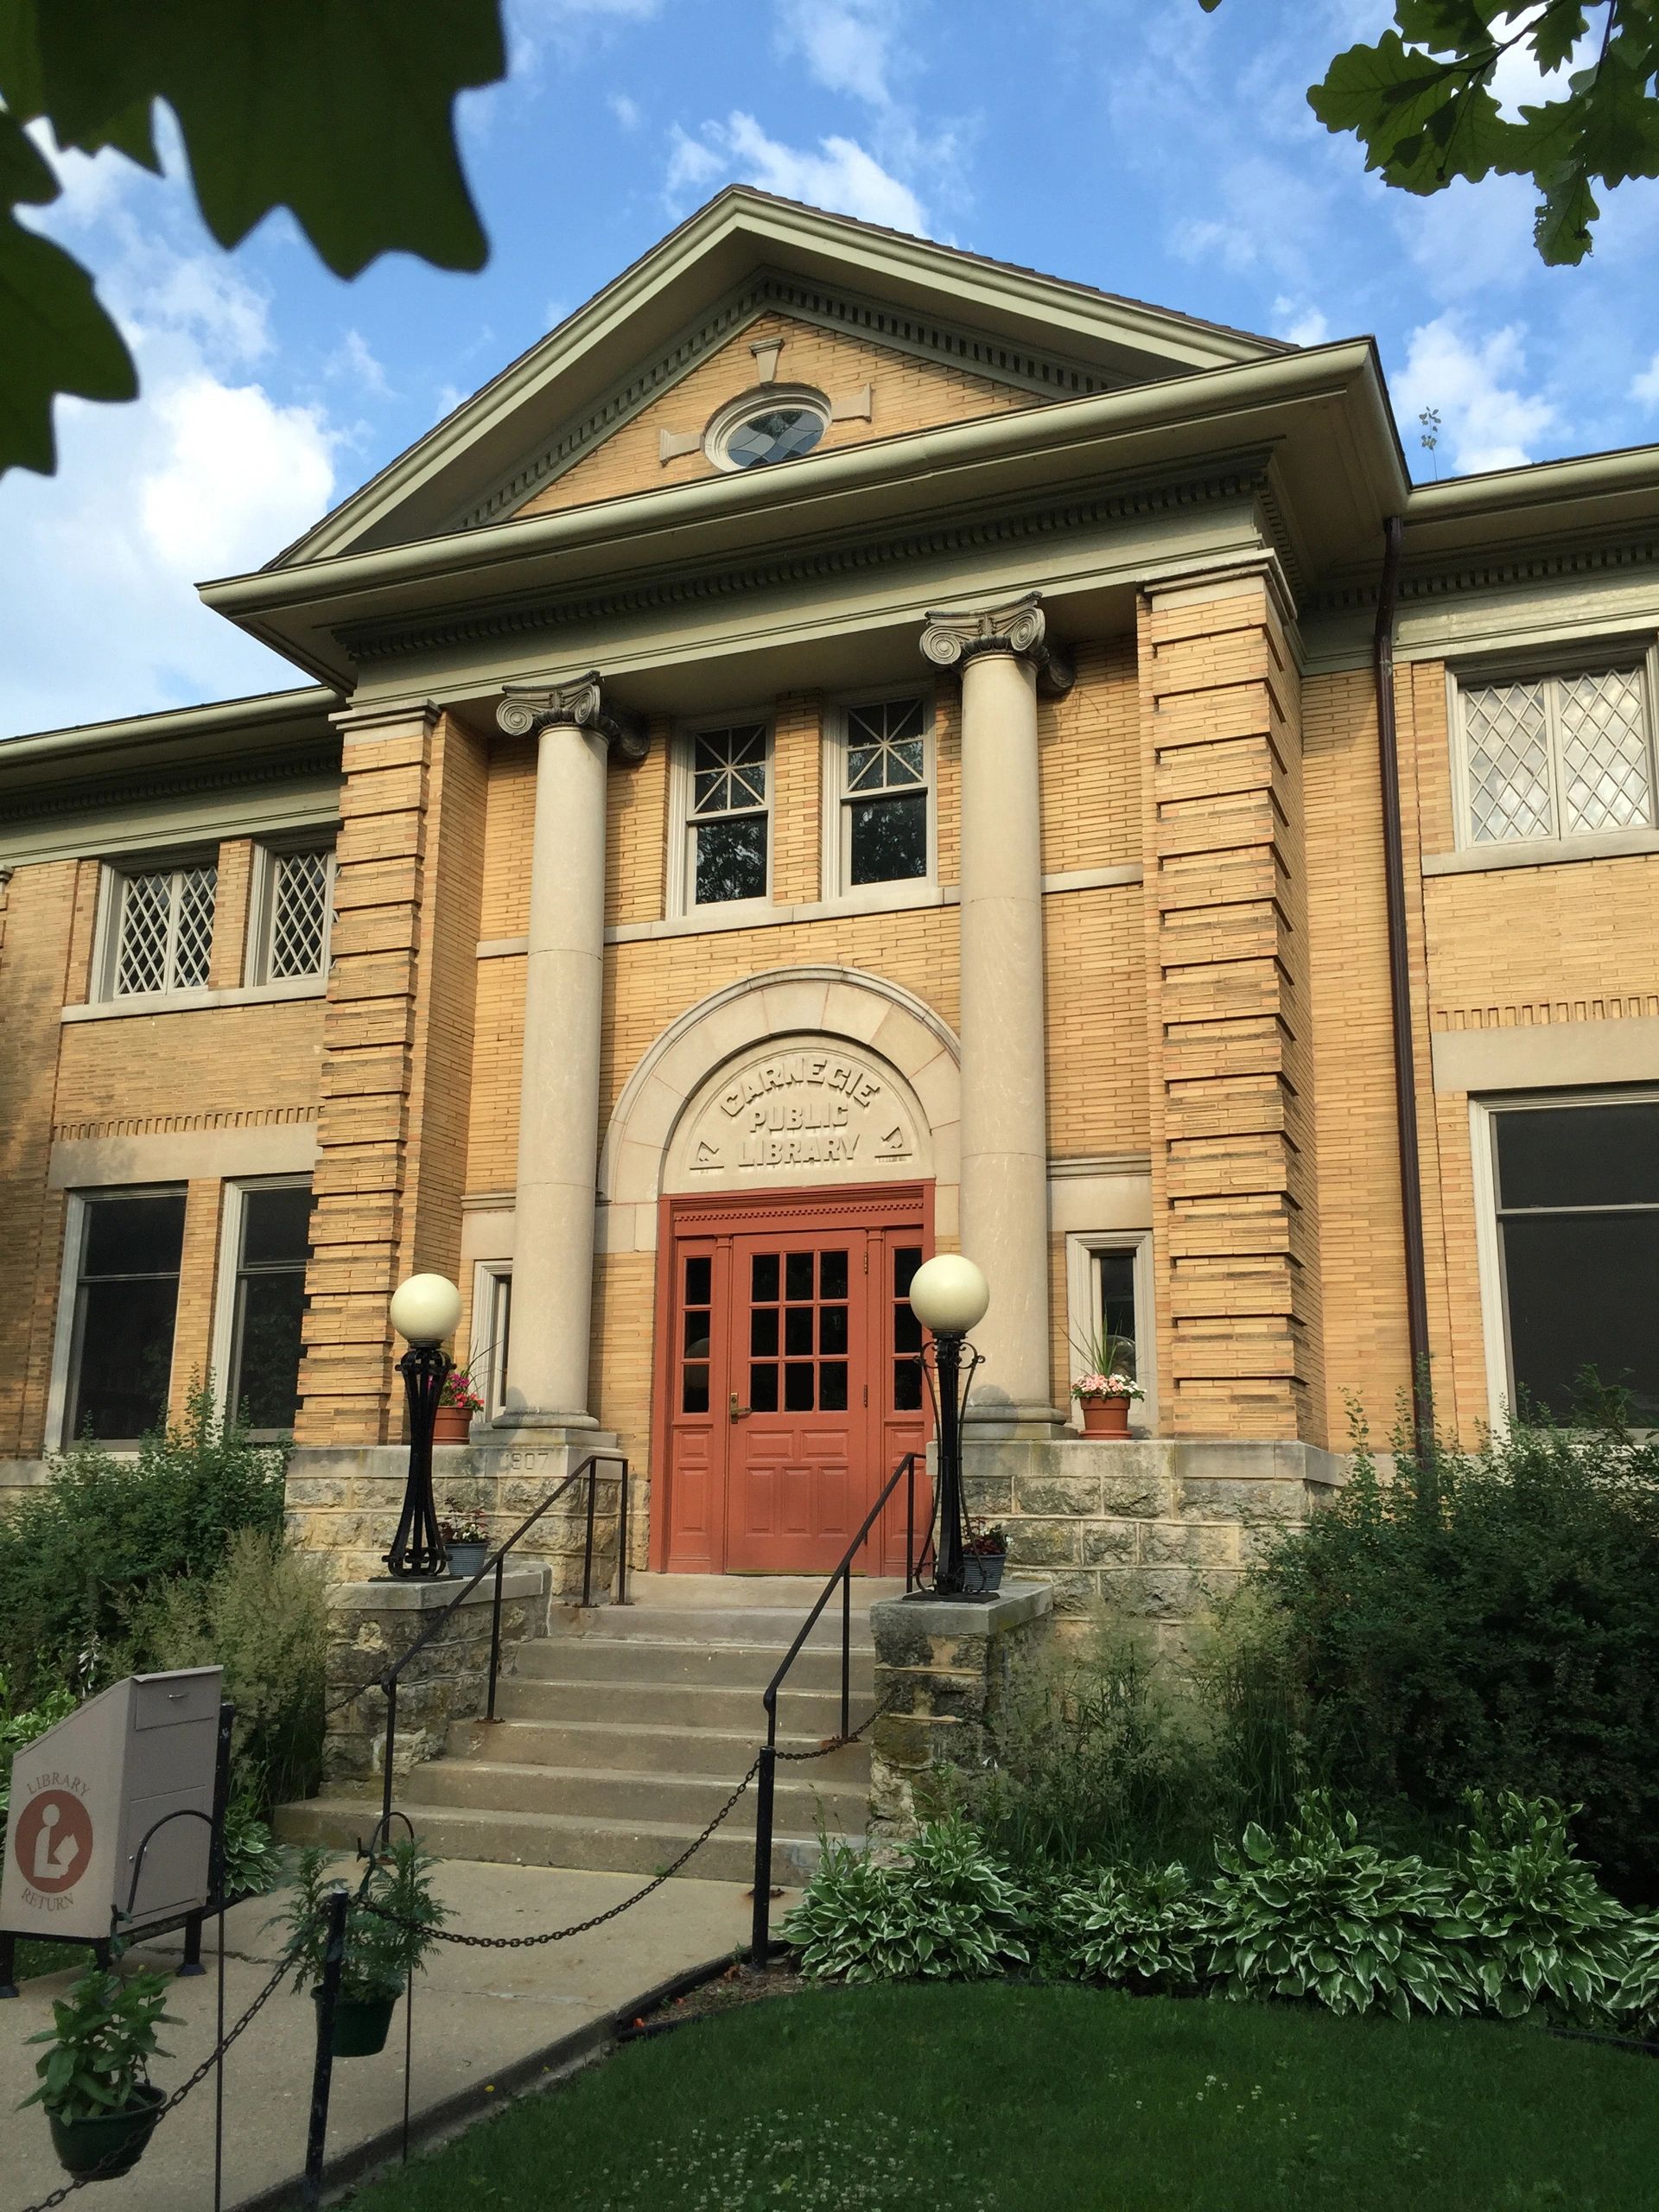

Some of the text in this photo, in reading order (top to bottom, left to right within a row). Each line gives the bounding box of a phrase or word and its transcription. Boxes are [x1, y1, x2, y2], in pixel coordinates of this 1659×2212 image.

[720, 1057, 880, 1116] CARNEGIE
[749, 1103, 849, 1133] PUBLIC
[738, 1134, 861, 1166] LIBRARY
[27, 1771, 91, 1796] LIBRARY
[22, 1887, 74, 1911] RETURN
